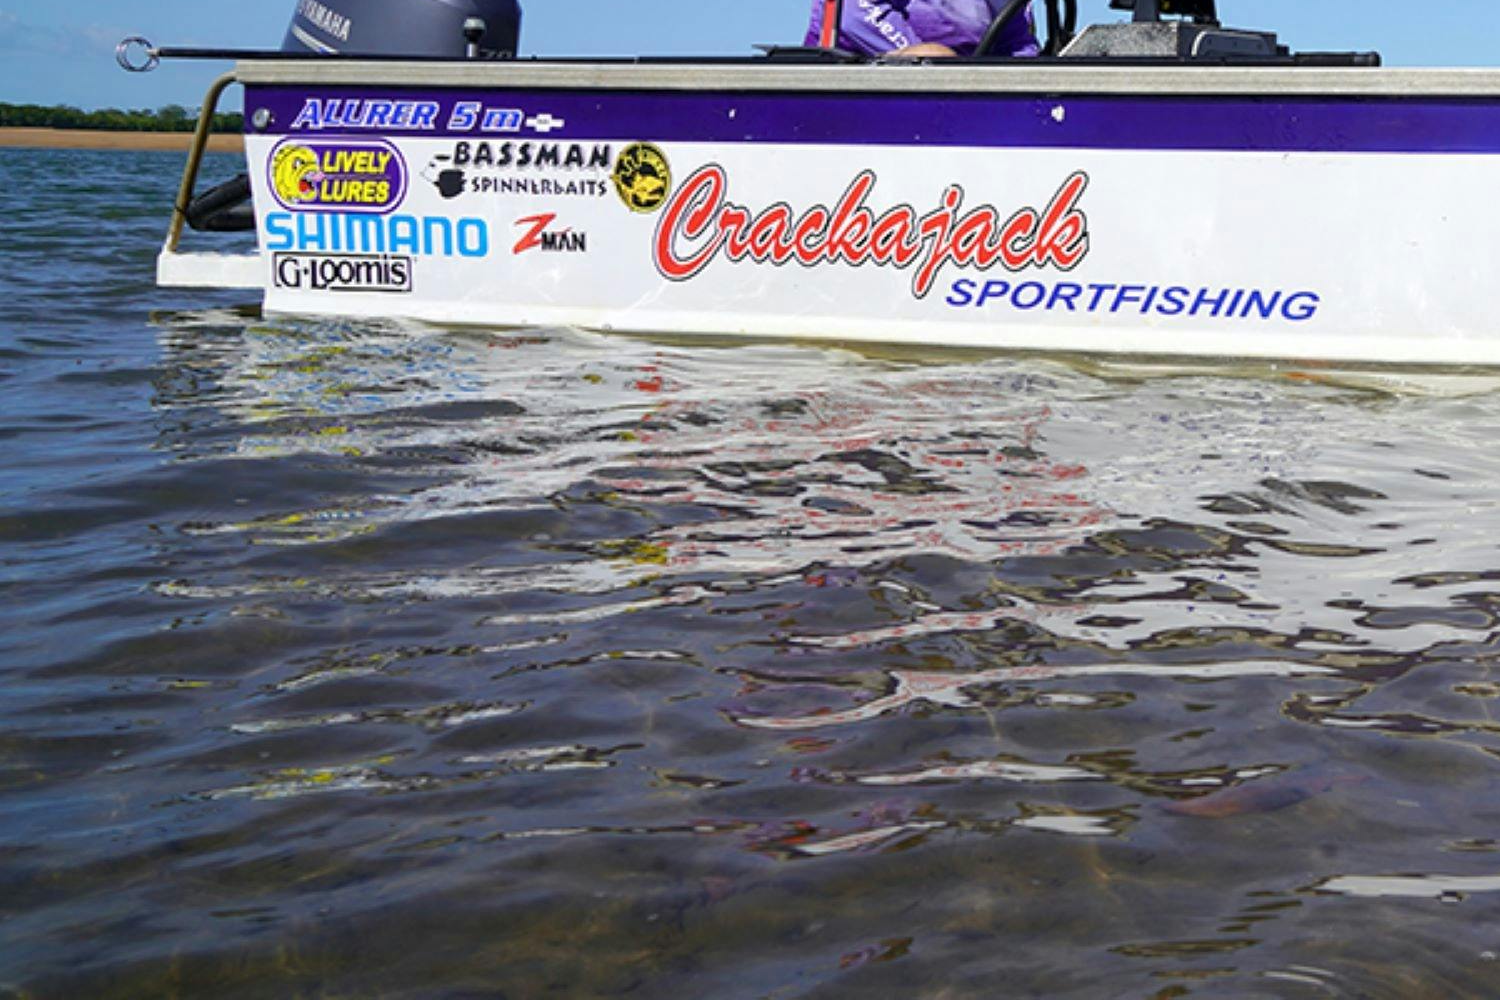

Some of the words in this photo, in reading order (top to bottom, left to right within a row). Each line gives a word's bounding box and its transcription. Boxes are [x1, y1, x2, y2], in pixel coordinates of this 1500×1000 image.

[323, 151, 392, 174] LIVELY
[454, 141, 610, 168] BASSMAN
[320, 179, 390, 203] LURES
[265, 212, 488, 257] SHIMANO
[652, 163, 1090, 299] Crackajack
[945, 278, 1321, 321] SPORTFISHING
